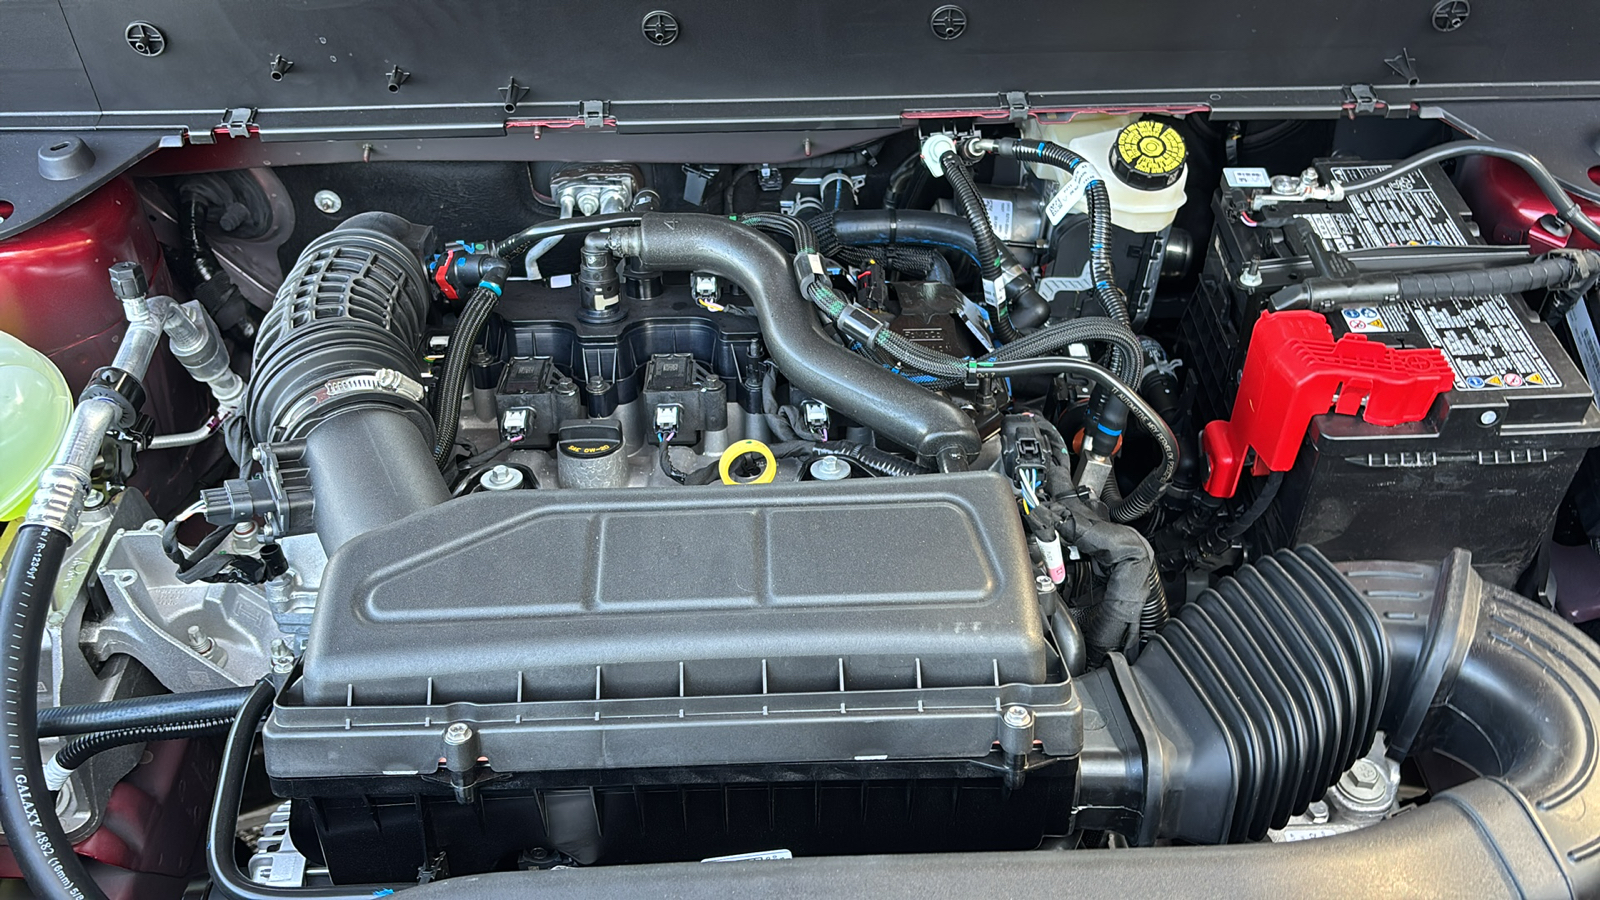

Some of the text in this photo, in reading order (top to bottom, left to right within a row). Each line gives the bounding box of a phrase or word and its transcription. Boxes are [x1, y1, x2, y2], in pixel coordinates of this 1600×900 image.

[1118, 393, 1149, 422] AUTOMOTIVE
[15, 774, 43, 827] GALAXY
[34, 830, 55, 857] 4882
[47, 857, 74, 890] (16mm)
